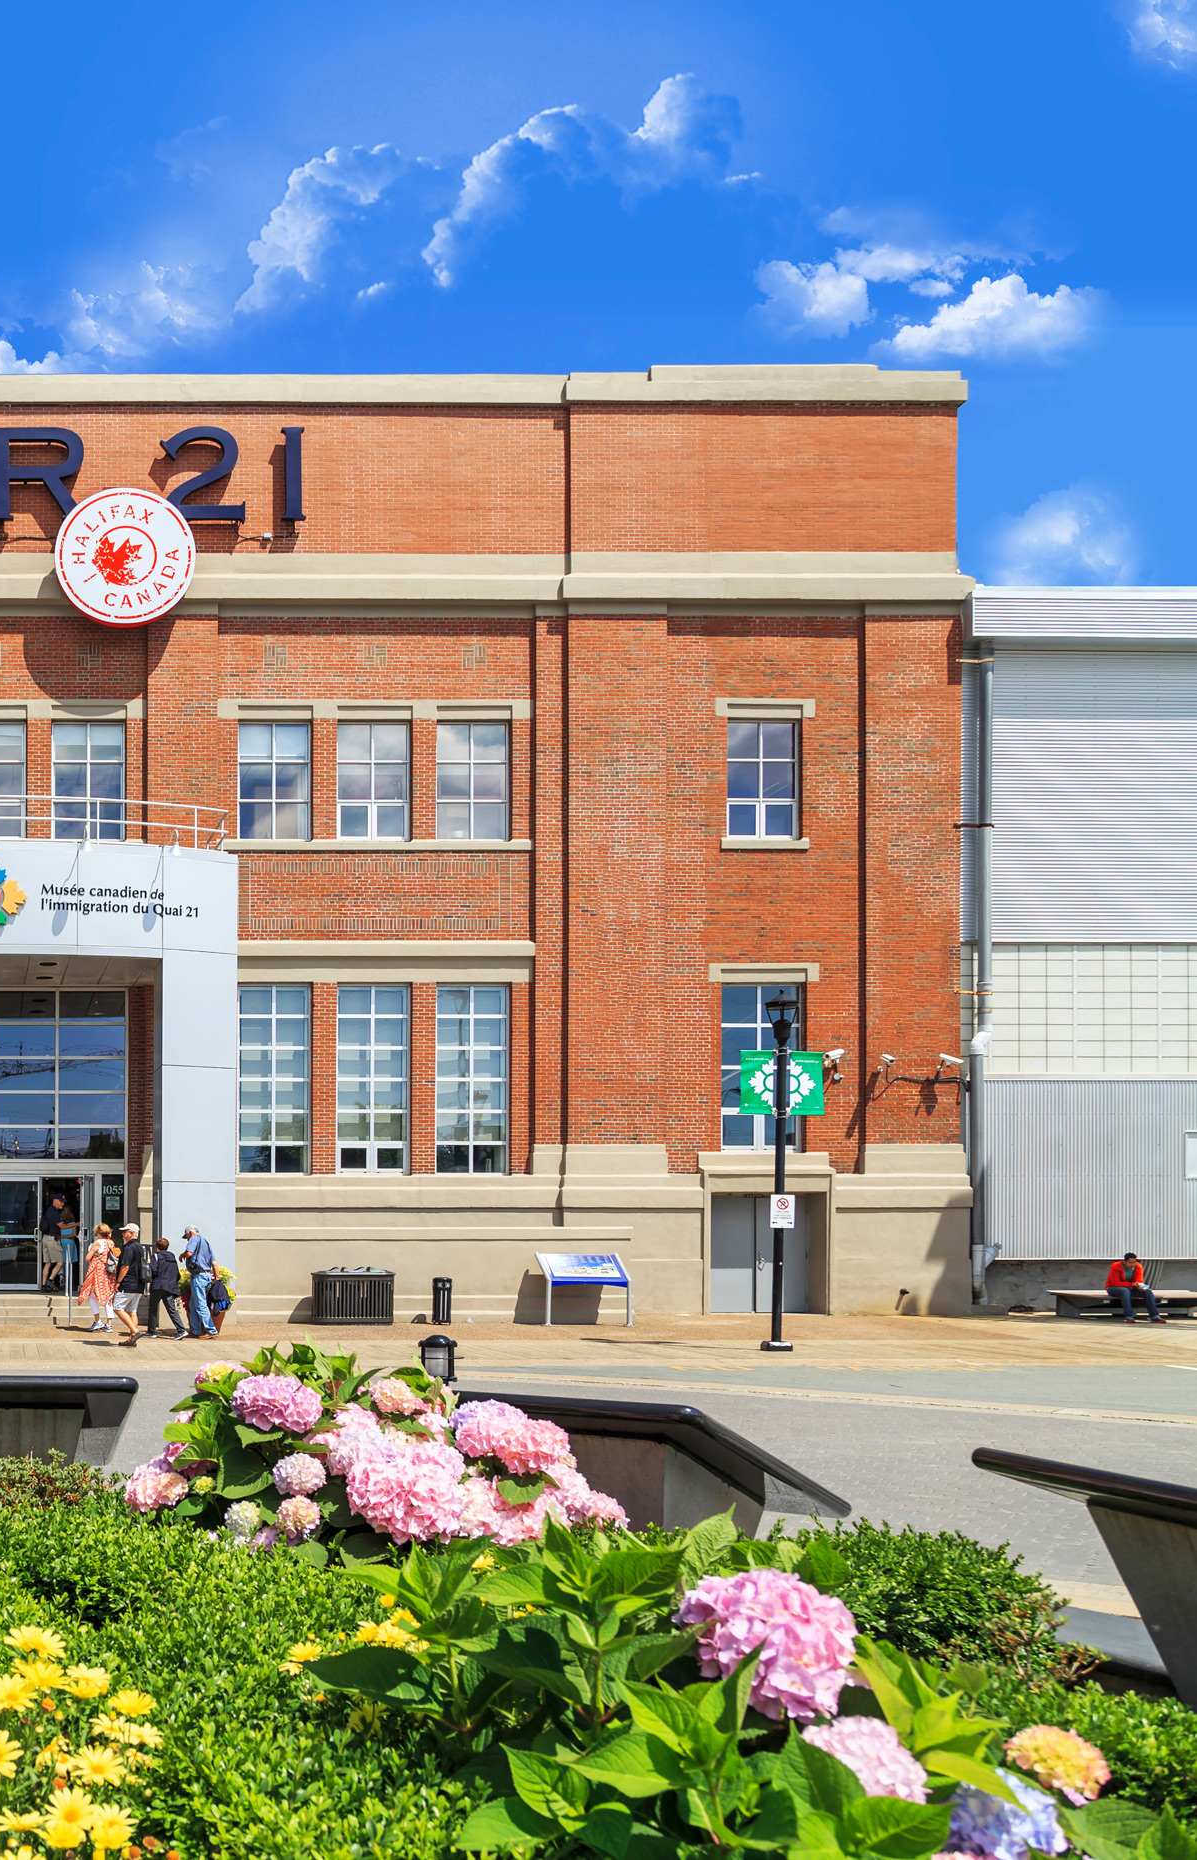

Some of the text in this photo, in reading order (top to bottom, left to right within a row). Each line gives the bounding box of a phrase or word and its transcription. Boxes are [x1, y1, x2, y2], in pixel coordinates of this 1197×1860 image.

[159, 425, 306, 525] 21
[71, 504, 155, 565] HALIFAX
[103, 548, 180, 609] CANADA
[40, 883, 165, 901] Musée canadien de
[40, 897, 199, 919] l'immigration du Quai 21
[102, 1185, 124, 1195] 1055
